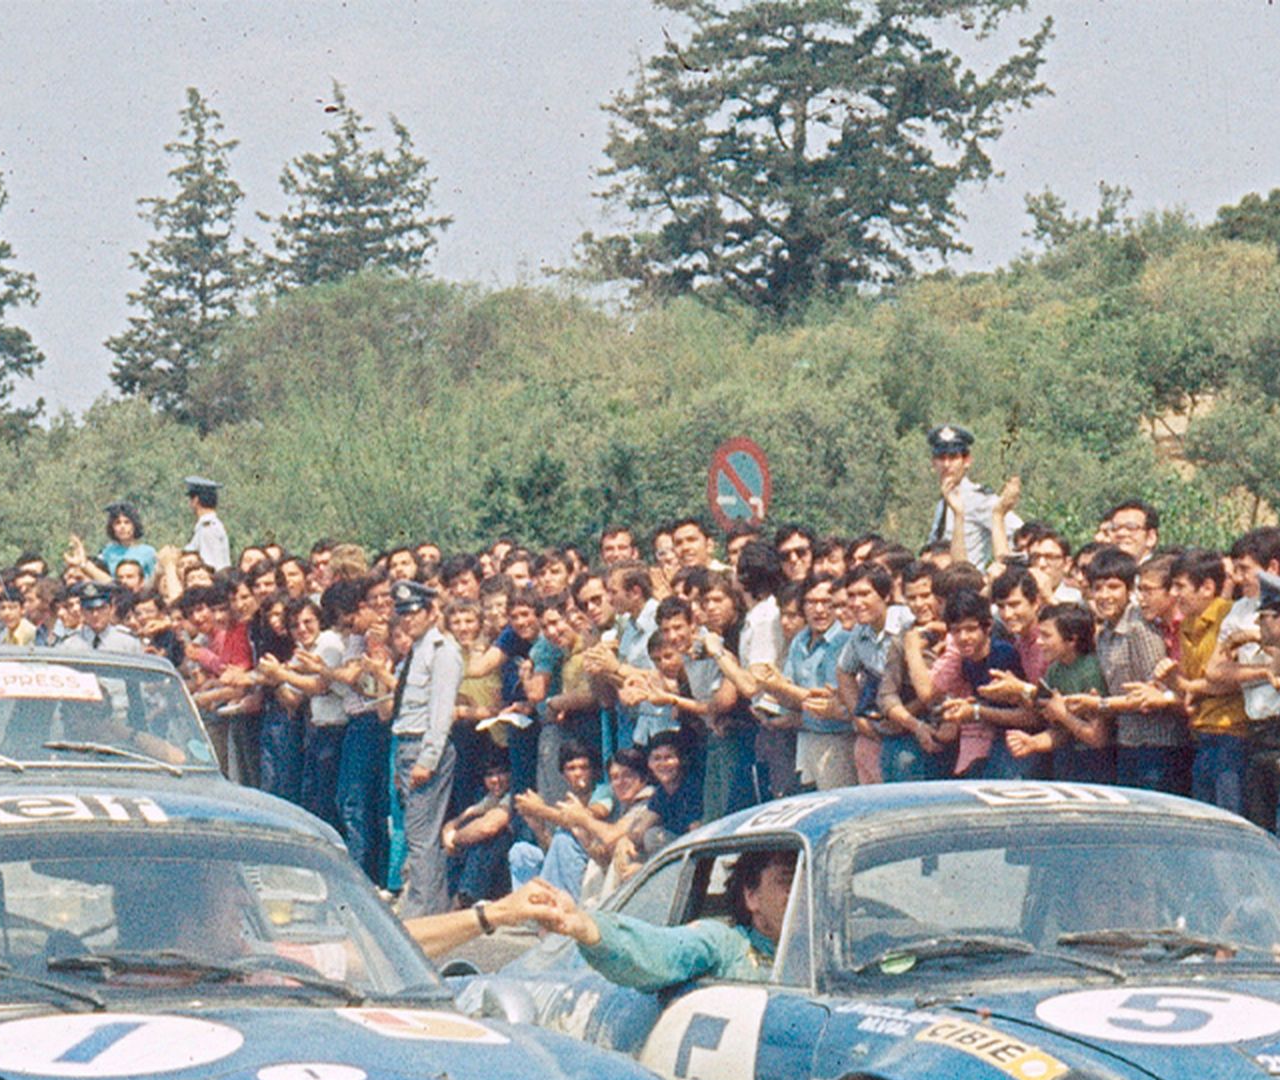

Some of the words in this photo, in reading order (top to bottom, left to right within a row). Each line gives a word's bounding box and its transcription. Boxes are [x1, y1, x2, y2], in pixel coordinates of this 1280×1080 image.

[3, 673, 81, 688] PRESS
[1107, 993, 1231, 1033] 5
[51, 1022, 148, 1064] 1
[927, 1023, 1027, 1062] CIBIE
